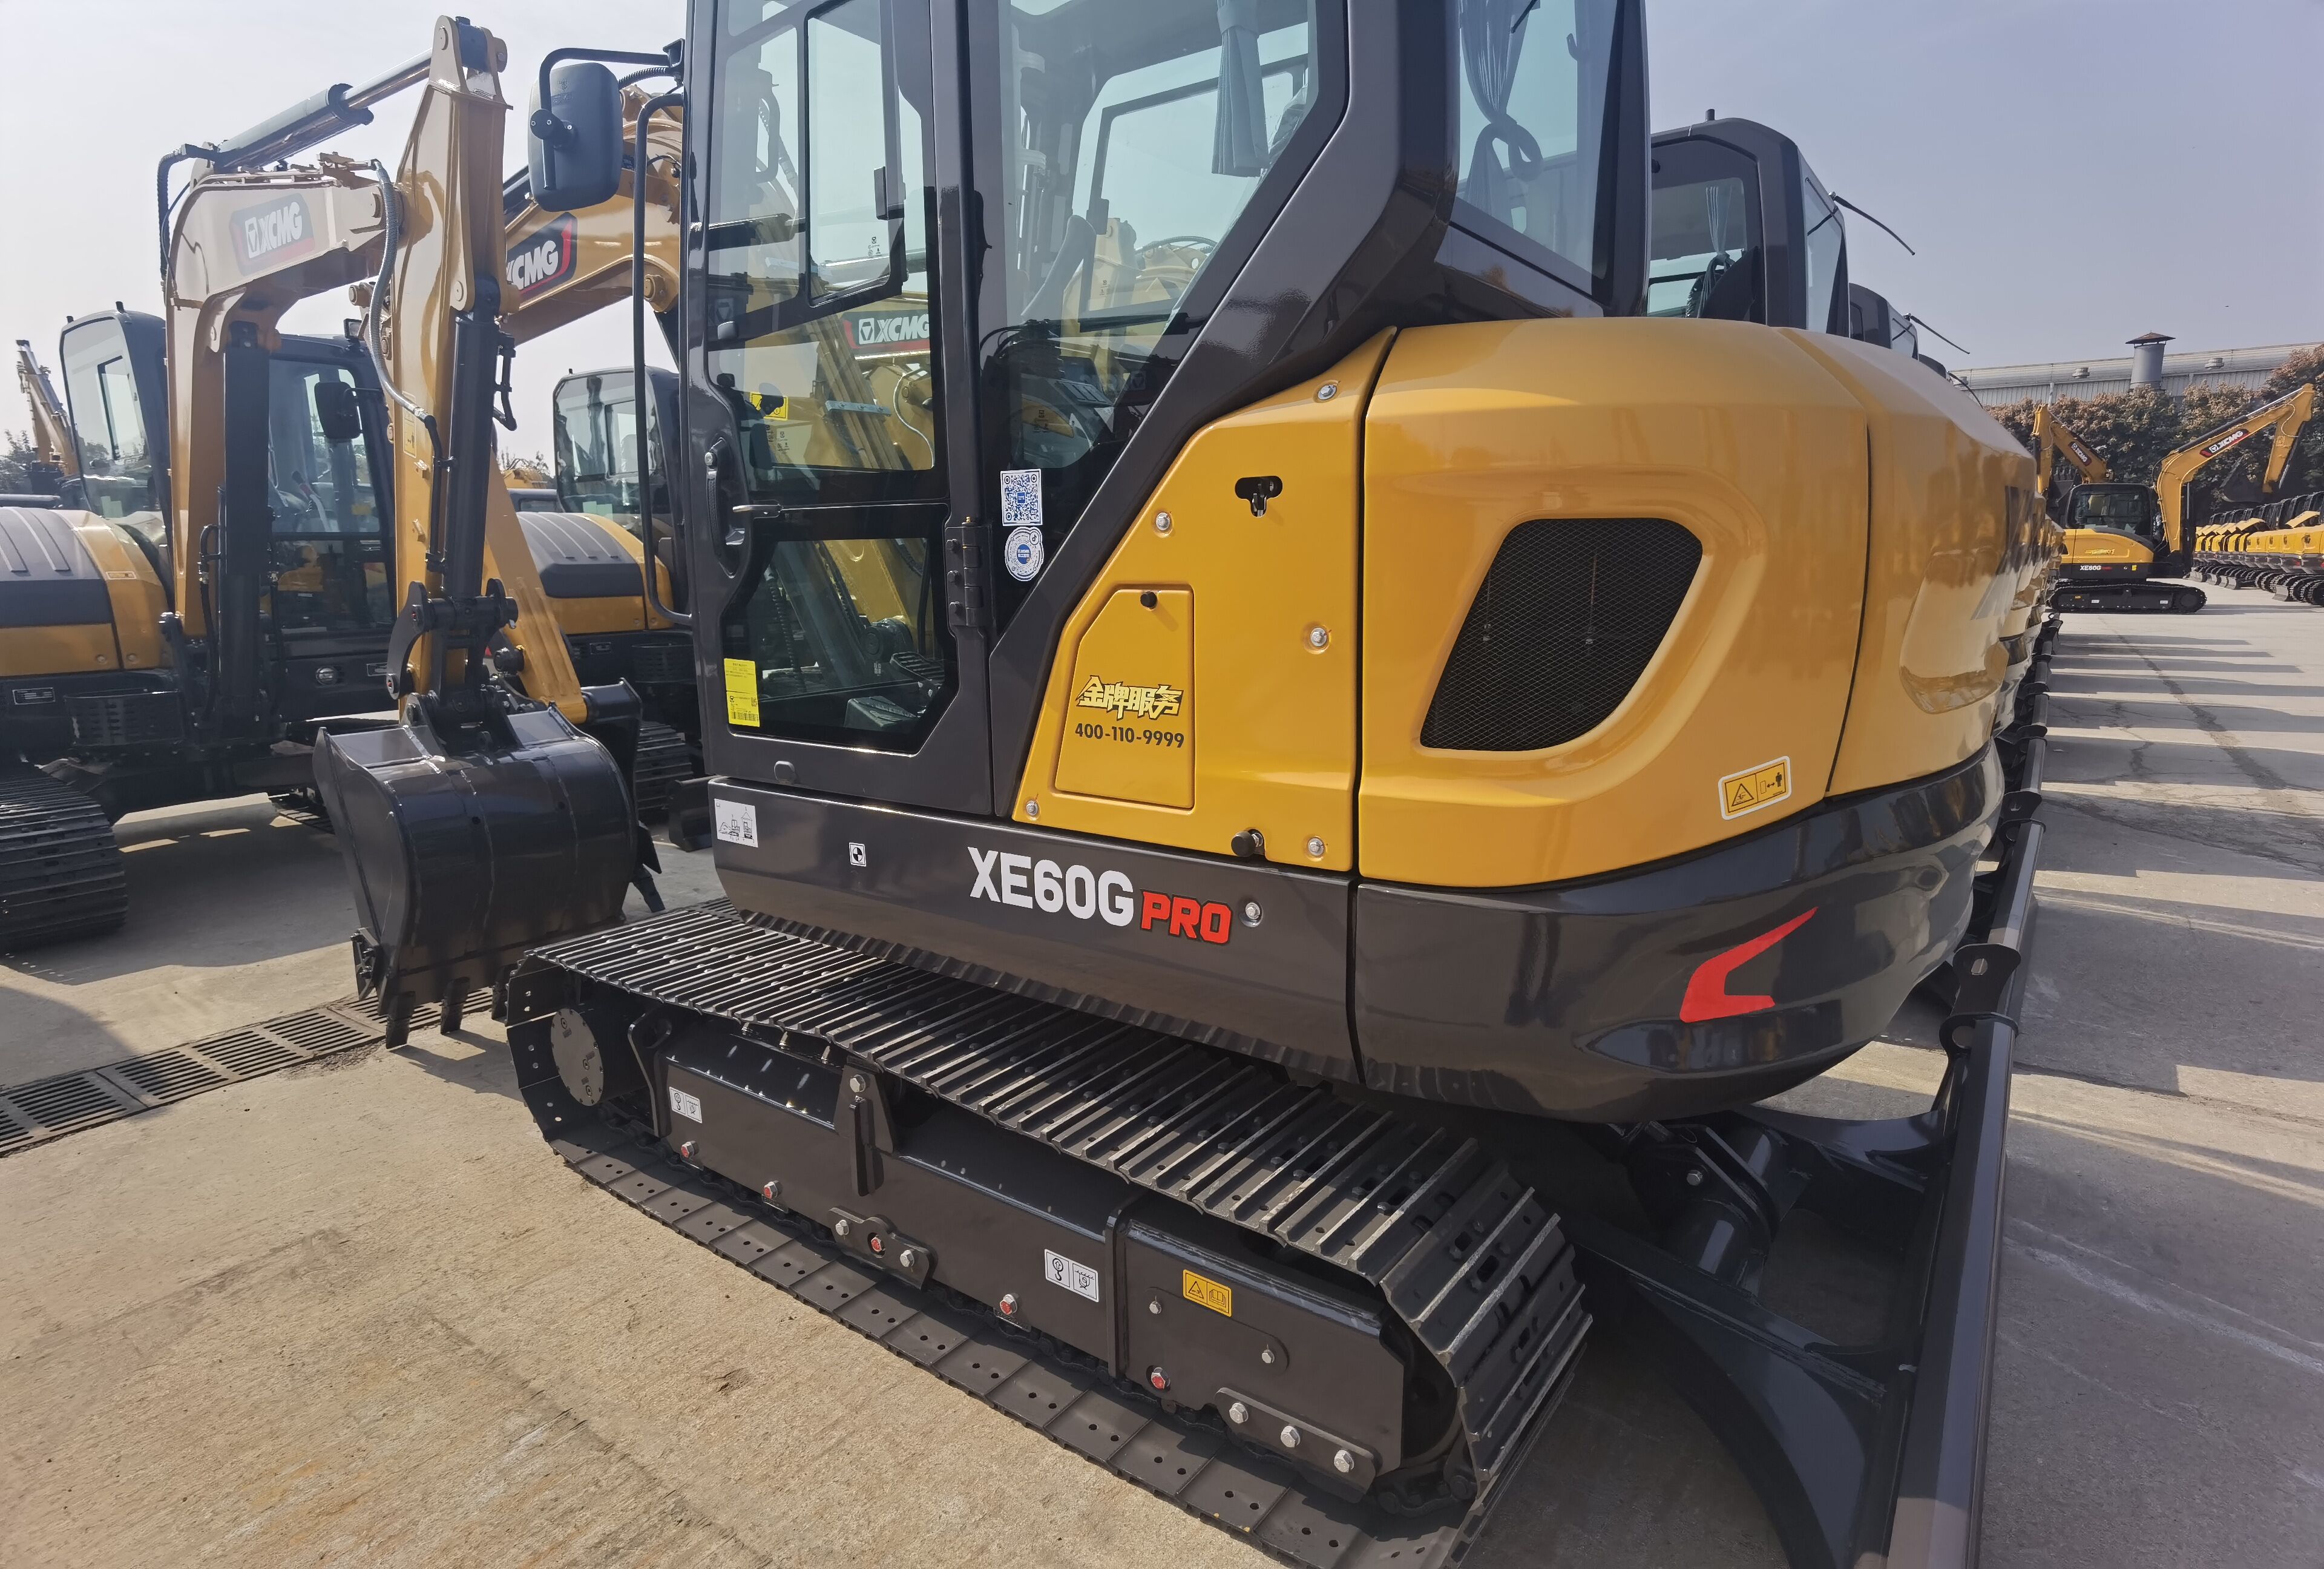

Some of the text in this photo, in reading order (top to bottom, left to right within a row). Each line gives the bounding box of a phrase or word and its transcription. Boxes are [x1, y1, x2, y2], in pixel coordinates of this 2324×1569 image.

[258, 202, 303, 254] XCMG
[874, 314, 930, 343] XCMG
[2217, 430, 2244, 449] XCMG
[1075, 675, 1184, 721] 金牌服务
[1075, 723, 1184, 748] 400-110-9999
[967, 846, 1233, 945] XE60G PRO
